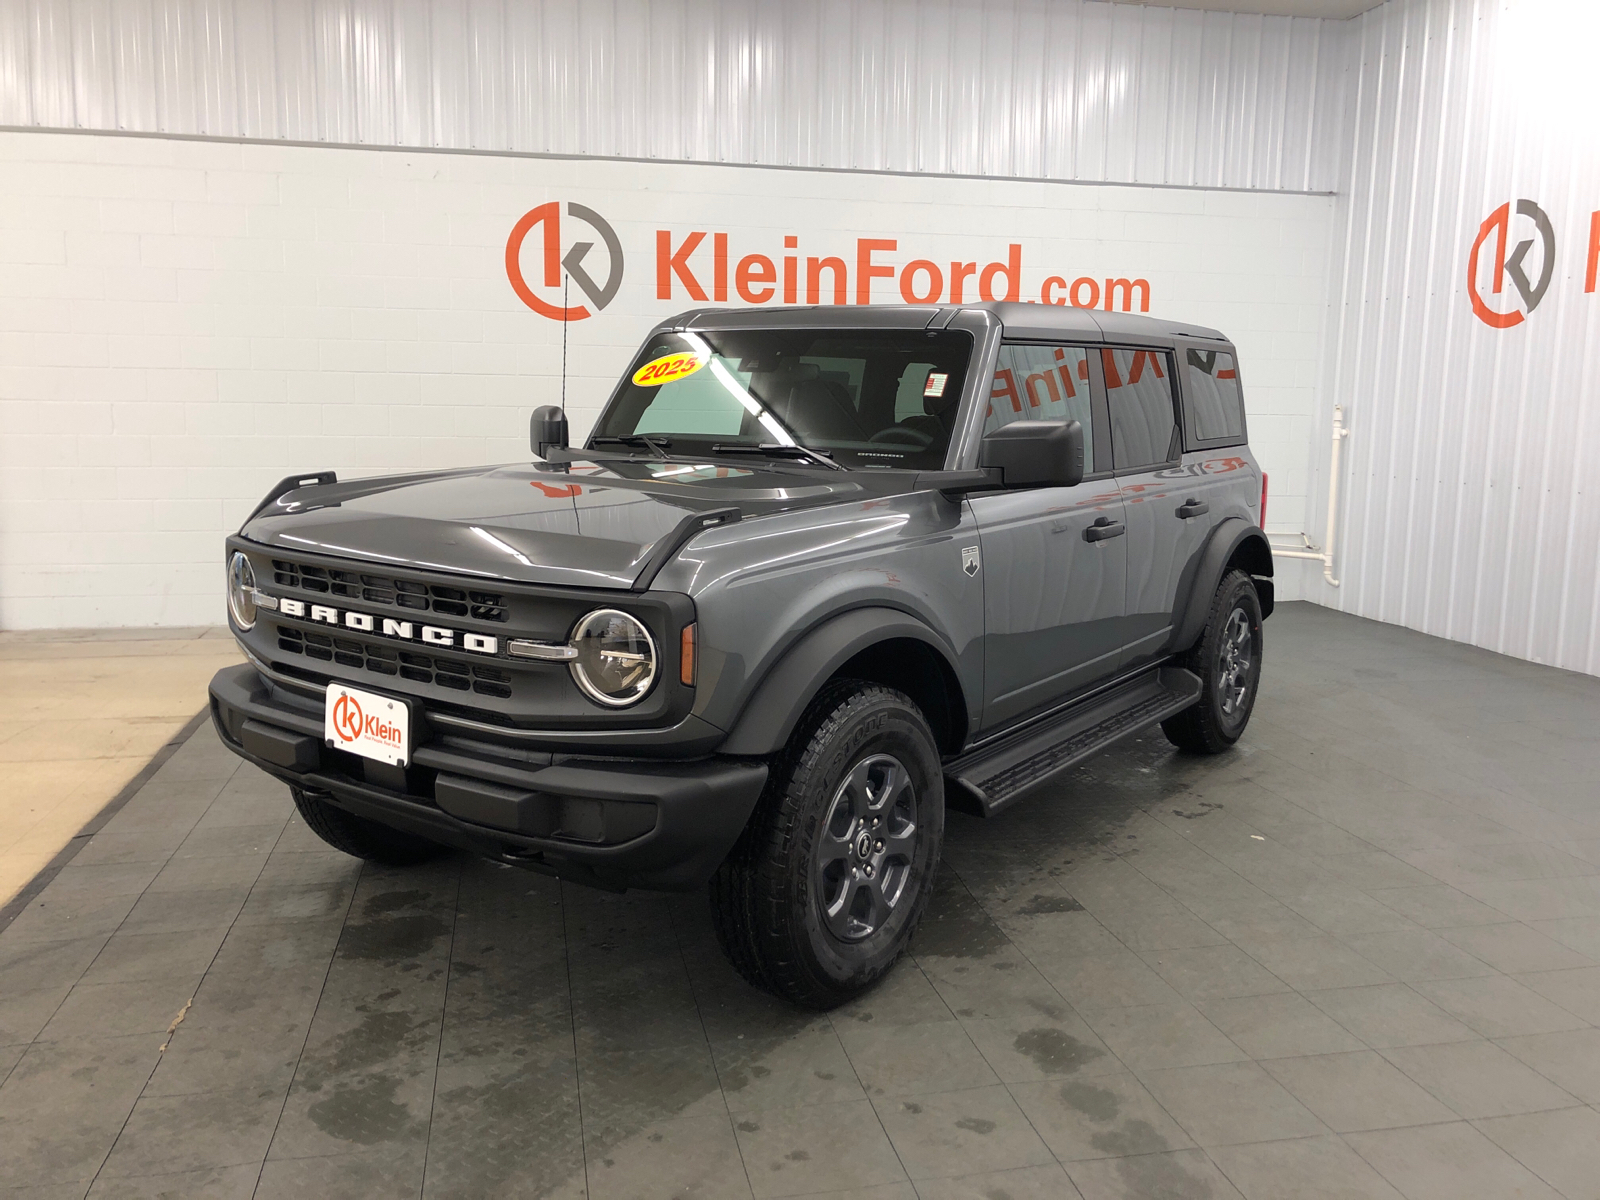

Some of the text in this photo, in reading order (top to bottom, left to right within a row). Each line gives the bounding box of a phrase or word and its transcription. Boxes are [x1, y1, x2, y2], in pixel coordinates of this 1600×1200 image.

[640, 356, 699, 382] 2025
[279, 598, 498, 654] BRONCO
[364, 713, 402, 744] Klein
